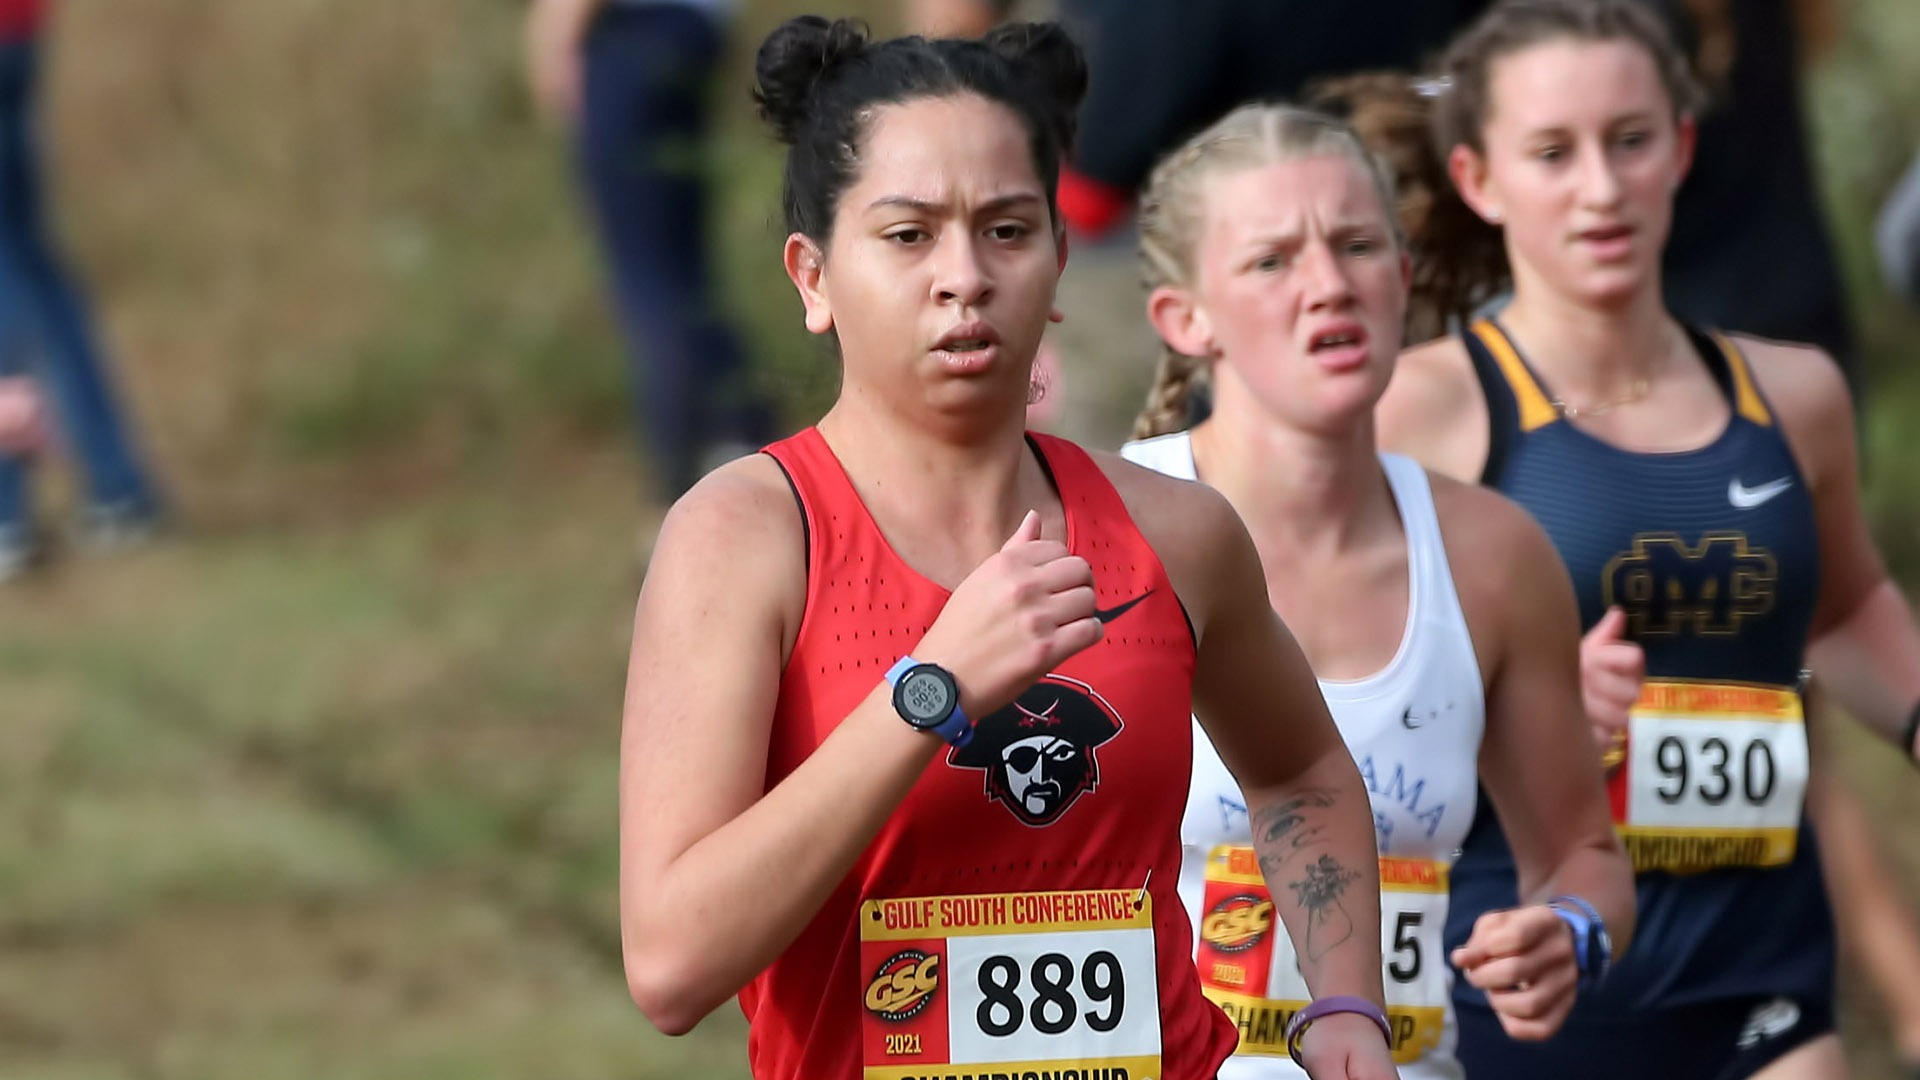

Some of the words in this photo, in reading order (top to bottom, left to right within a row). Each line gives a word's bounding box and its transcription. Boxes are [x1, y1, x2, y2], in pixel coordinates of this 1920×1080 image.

[1656, 735, 1776, 806] 930
[884, 900, 935, 930] GULF
[941, 896, 1006, 928] SOUTH
[1012, 892, 1134, 924] CONFERENCE
[865, 953, 939, 1013] GSC
[976, 950, 1126, 1038] 889
[885, 1034, 922, 1055] 2021
